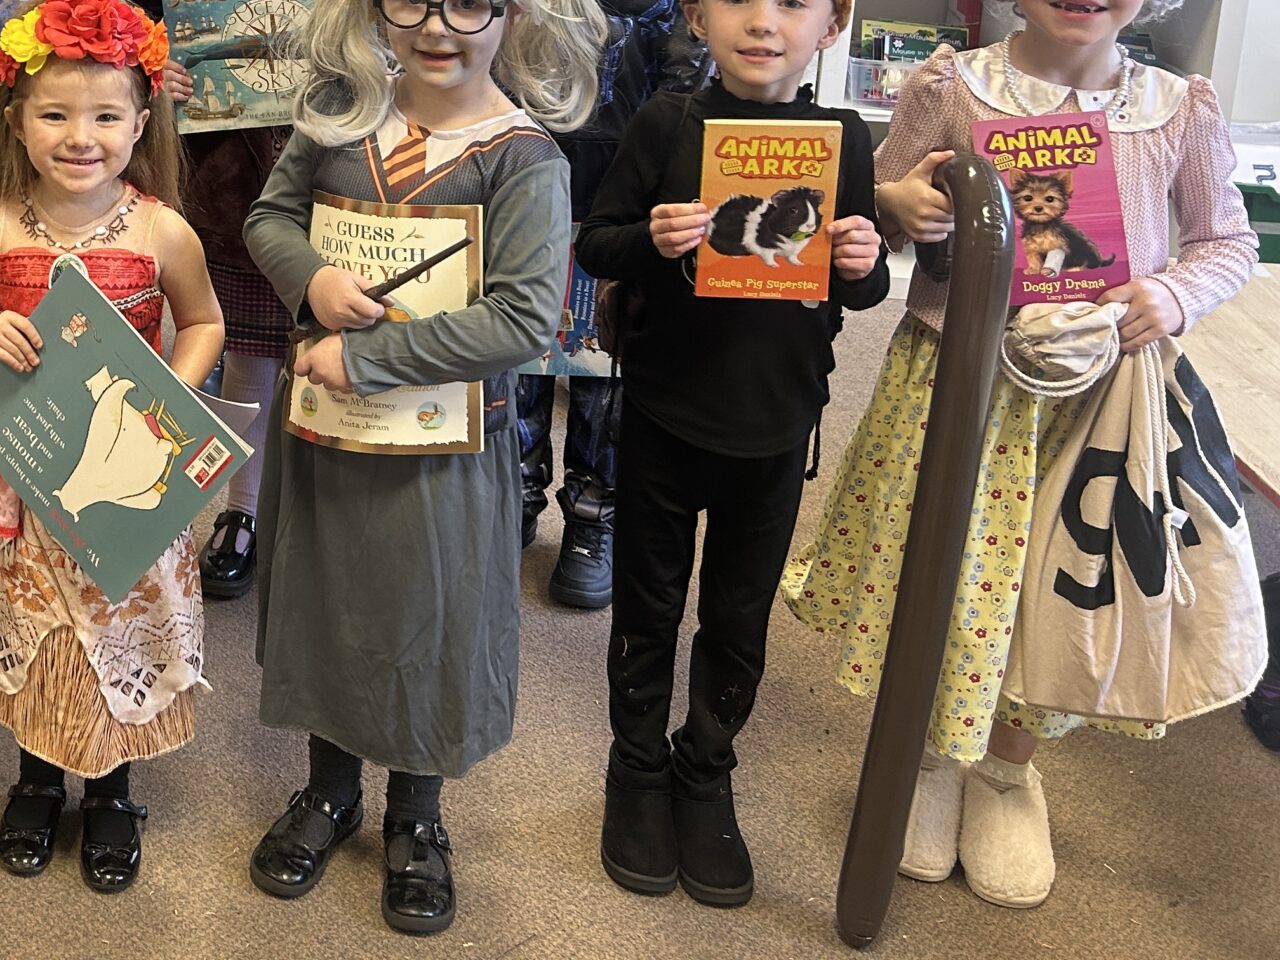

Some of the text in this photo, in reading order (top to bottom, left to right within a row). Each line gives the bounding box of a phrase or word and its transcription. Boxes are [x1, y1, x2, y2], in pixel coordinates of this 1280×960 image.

[224, 0, 301, 27] OCEAN
[251, 67, 293, 95] SKY
[742, 158, 801, 176] ARK
[1016, 148, 1073, 169] ARK
[337, 220, 395, 243] GUESS
[321, 235, 426, 262] HOW MUCH
[707, 276, 819, 291] Guinea Pig Superstar
[1022, 278, 1106, 294] Doggy Drama
[46, 395, 66, 422] chair.
[331, 394, 348, 404] Sam
[23, 397, 66, 450] with just one
[338, 418, 390, 431] Anita Jeram
[2, 426, 39, 470] mouse
[12, 415, 53, 460] and bear
[6, 454, 29, 481] happy
[31, 485, 50, 508] make
[86, 547, 100, 568] We
